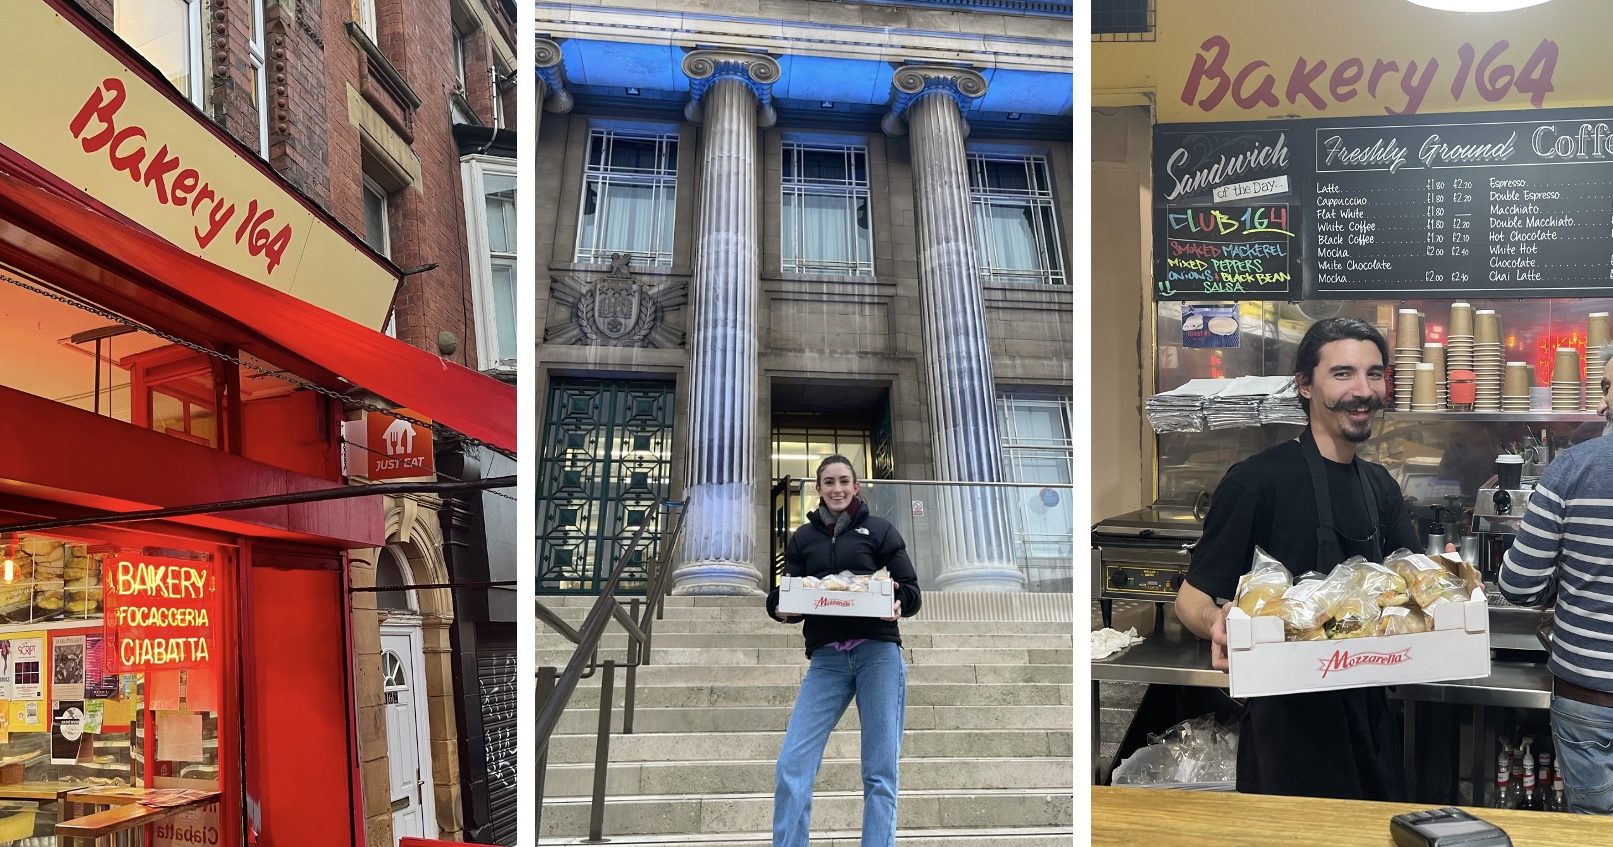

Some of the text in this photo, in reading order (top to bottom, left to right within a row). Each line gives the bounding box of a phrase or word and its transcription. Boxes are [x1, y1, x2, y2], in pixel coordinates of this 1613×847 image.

[1181, 35, 1559, 115] Bakery 164
[1324, 135, 1407, 173] Freshly
[1418, 130, 1518, 167] Ground
[1164, 133, 1289, 200] Sandwich
[69, 78, 292, 275] Bakery 164
[1489, 177, 1526, 189] Espresso
[1217, 187, 1230, 199] of
[1233, 183, 1252, 197] the
[1316, 182, 1340, 193] Latte
[1316, 196, 1367, 207] Cappuccino
[1490, 190, 1560, 201] Double Espresso
[1316, 209, 1336, 219] Flat
[1340, 209, 1364, 219] White
[1490, 203, 1540, 214] Macchiato
[1168, 207, 1287, 235] CLUB 164
[1317, 222, 1344, 232] White
[1348, 221, 1376, 233] Coffee
[1490, 215, 1574, 228] Double Macchiato
[1318, 234, 1343, 245] Black
[1348, 233, 1375, 246] Coffee
[1489, 230, 1557, 241] Hot Chocolate
[1170, 241, 1287, 259] SMOKED MACKEREL
[1317, 248, 1349, 258] Mocha
[1490, 243, 1538, 254] White Hot
[1211, 259, 1264, 273] PEPPERS
[1318, 259, 1392, 270] White Chocolate
[1490, 257, 1536, 268] Chocolate
[1220, 272, 1255, 283] BLACK
[1255, 271, 1292, 286] BEAN
[1318, 273, 1347, 283] Mocha
[1489, 269, 1541, 281] Chai Latte
[1203, 281, 1246, 294] SALSA
[375, 456, 425, 472] JUST EAT
[118, 561, 207, 598] BAKERY
[119, 606, 209, 627] FOCACCERIA
[121, 637, 209, 666] CIABATTA
[1322, 649, 1402, 679] Mozzarella
